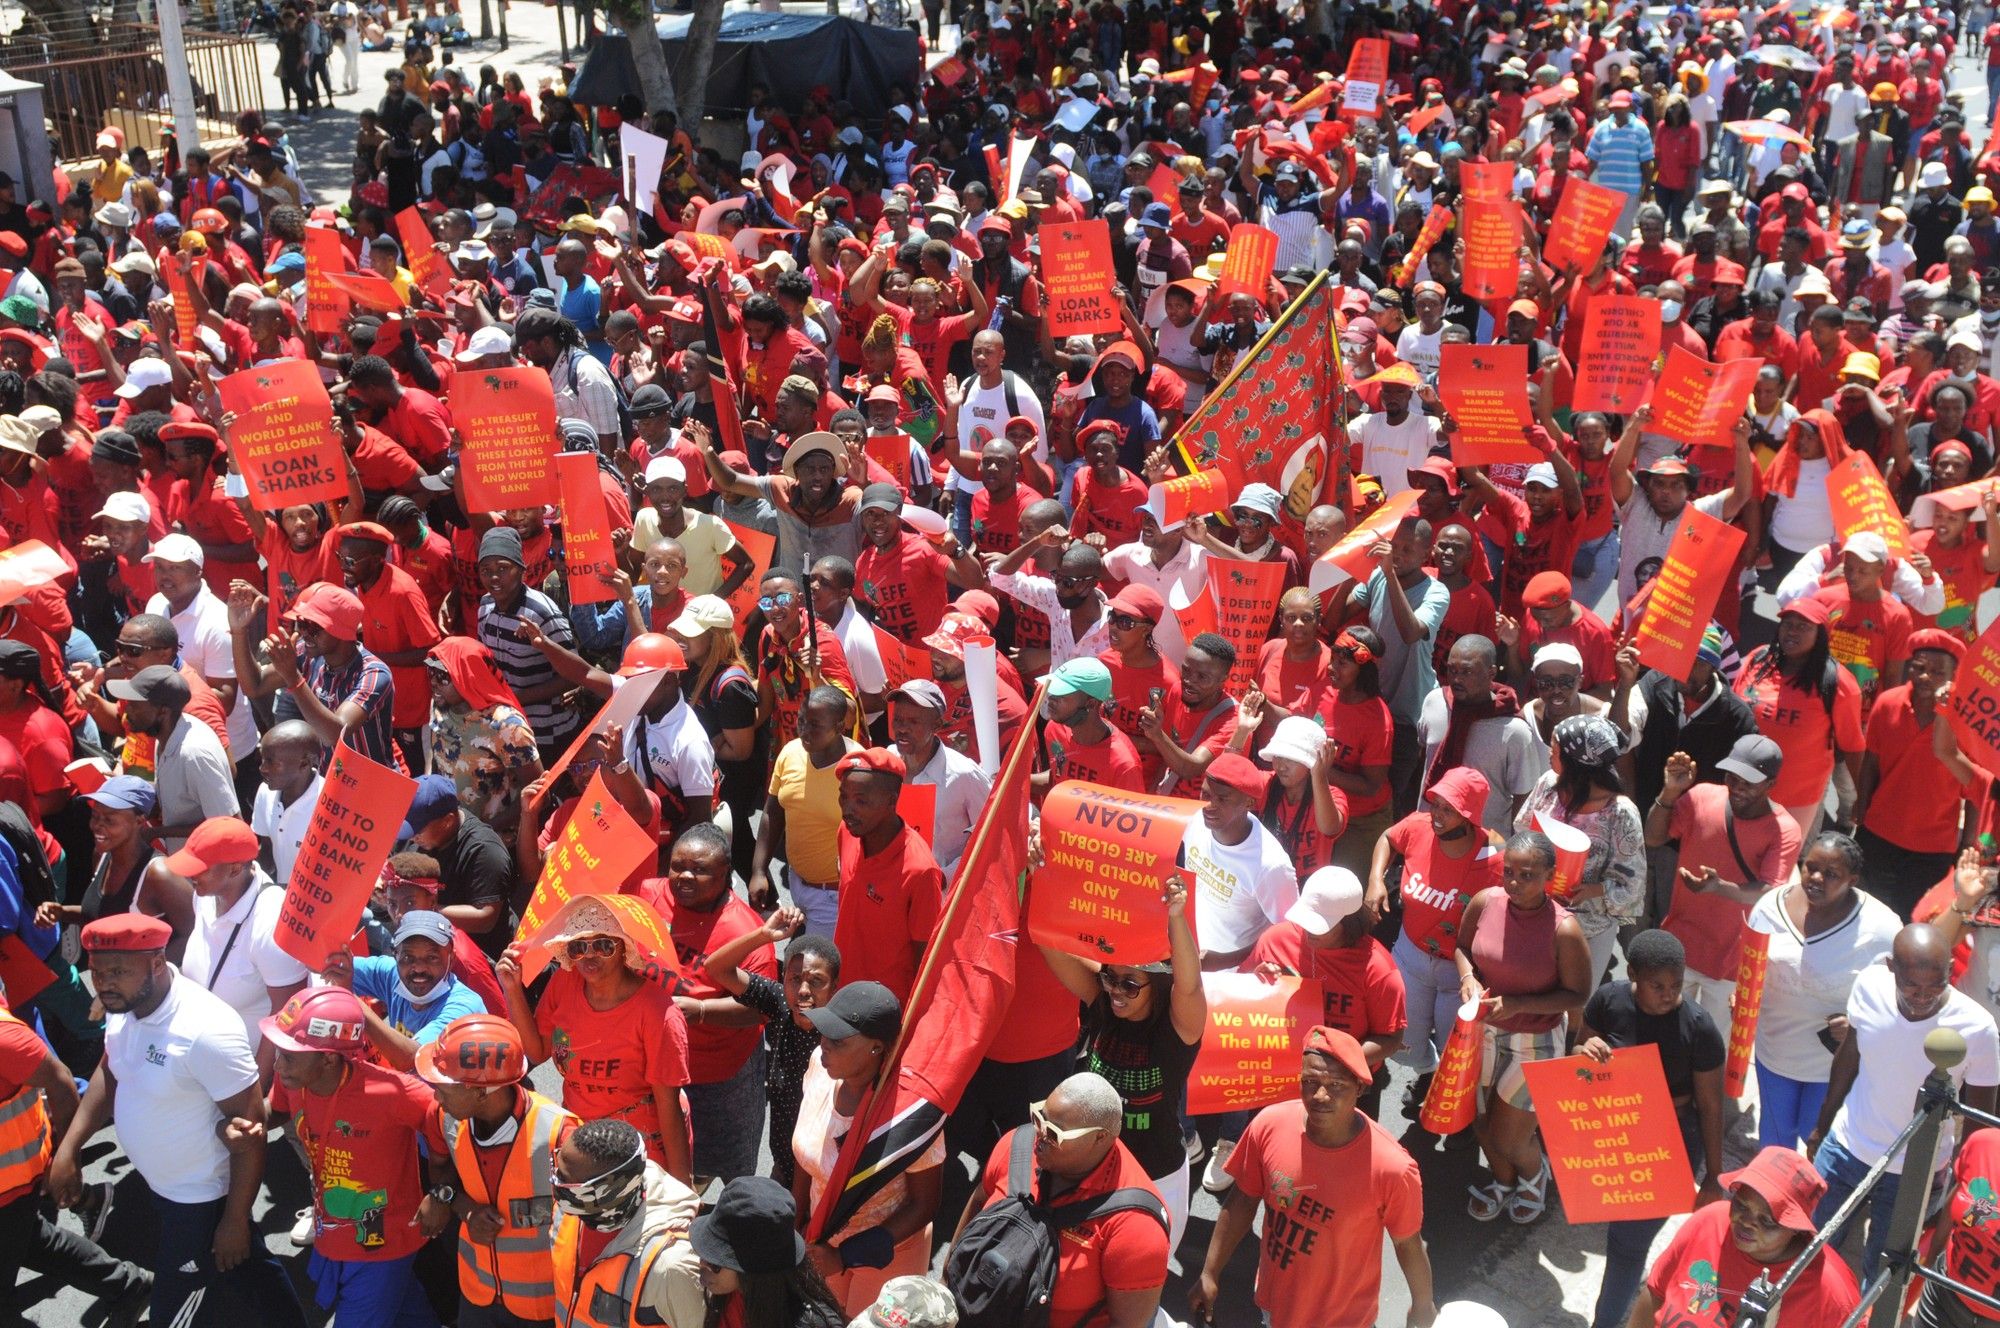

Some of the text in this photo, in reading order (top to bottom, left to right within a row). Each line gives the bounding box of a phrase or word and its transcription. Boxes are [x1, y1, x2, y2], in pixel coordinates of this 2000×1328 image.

[1056, 250, 1091, 262] THE IMF
[1064, 262, 1085, 272] AND
[1047, 271, 1106, 284] WORLD BANK
[1051, 282, 1105, 295] ARE GLOBAL
[1060, 296, 1100, 311] LOAN
[1055, 307, 1112, 324] SHARKS
[1600, 307, 1645, 318] CHILDREN
[1604, 319, 1639, 328] BY OUR
[1596, 330, 1645, 340] INHERITED
[1587, 352, 1649, 362] WORLD BANK
[1587, 364, 1607, 372] AND
[1630, 367, 1646, 375] THE
[503, 380, 519, 390] EFF
[1587, 375, 1643, 385] THE DEBT TO
[1476, 389, 1505, 397] WORLD
[277, 395, 299, 409] IMF
[265, 412, 293, 426] AND
[471, 411, 538, 427] SA TREASURY
[1456, 407, 1516, 415] INTERNATIONAL
[238, 421, 324, 445] WORLD BANK
[472, 425, 541, 438] HAS NO IDEA
[248, 435, 324, 458] ARE GLOBAL
[465, 434, 552, 450] WHY WE RECEIVE
[476, 447, 544, 461] THESE LOANS
[261, 454, 319, 478] LOAN
[476, 458, 548, 473] FROM THE IMF
[257, 467, 336, 494] SHARKS
[481, 471, 546, 485] AND WORLD
[500, 483, 531, 494] BANK
[565, 529, 600, 544] Bank
[987, 530, 1014, 548] EFF
[1245, 578, 1258, 586] EFF
[881, 583, 908, 601] EFF
[1229, 598, 1272, 610] DEBT TO
[877, 602, 916, 623] OTE
[1226, 613, 1271, 625] IMF AND
[1246, 644, 1258, 654] BE
[1762, 703, 1802, 725] EFF
[656, 756, 672, 767] EFF
[1067, 761, 1098, 783] EFF
[340, 774, 359, 790] EFF
[320, 792, 376, 834] DEBT TO
[1075, 801, 1153, 839] LOAN
[314, 813, 370, 854] MF AND
[596, 818, 611, 833] EFF
[1058, 829, 1159, 868] ARE GLOBAL
[319, 841, 366, 876] BANK
[558, 845, 572, 872] The
[575, 843, 601, 871] and
[313, 861, 332, 881] BE
[1051, 848, 1161, 892] WORLD BANK
[1189, 846, 1238, 887] G-STAR
[1082, 879, 1121, 901] AND
[1404, 872, 1459, 912] Sunf
[289, 891, 316, 920] OUR
[1068, 896, 1132, 926] THE IMF
[1077, 931, 1095, 945] EFF
[1212, 1012, 1298, 1029] We Want
[1219, 1033, 1291, 1050] The IMF
[458, 1040, 511, 1071] EFF
[1237, 1055, 1273, 1071] and
[579, 1058, 622, 1078] EFF
[1200, 1074, 1256, 1087] World
[1596, 1072, 1614, 1082] EFF
[1223, 1085, 1286, 1098] Out Of
[1439, 1100, 1461, 1111] Of
[1556, 1092, 1644, 1114] We Want
[1570, 1111, 1641, 1132] The IMF
[1593, 1131, 1630, 1149] and
[1561, 1147, 1672, 1170] World Bank
[1590, 1168, 1654, 1188] Out Of
[1601, 1190, 1656, 1205] Africa
[1297, 1195, 1336, 1224] EFF
